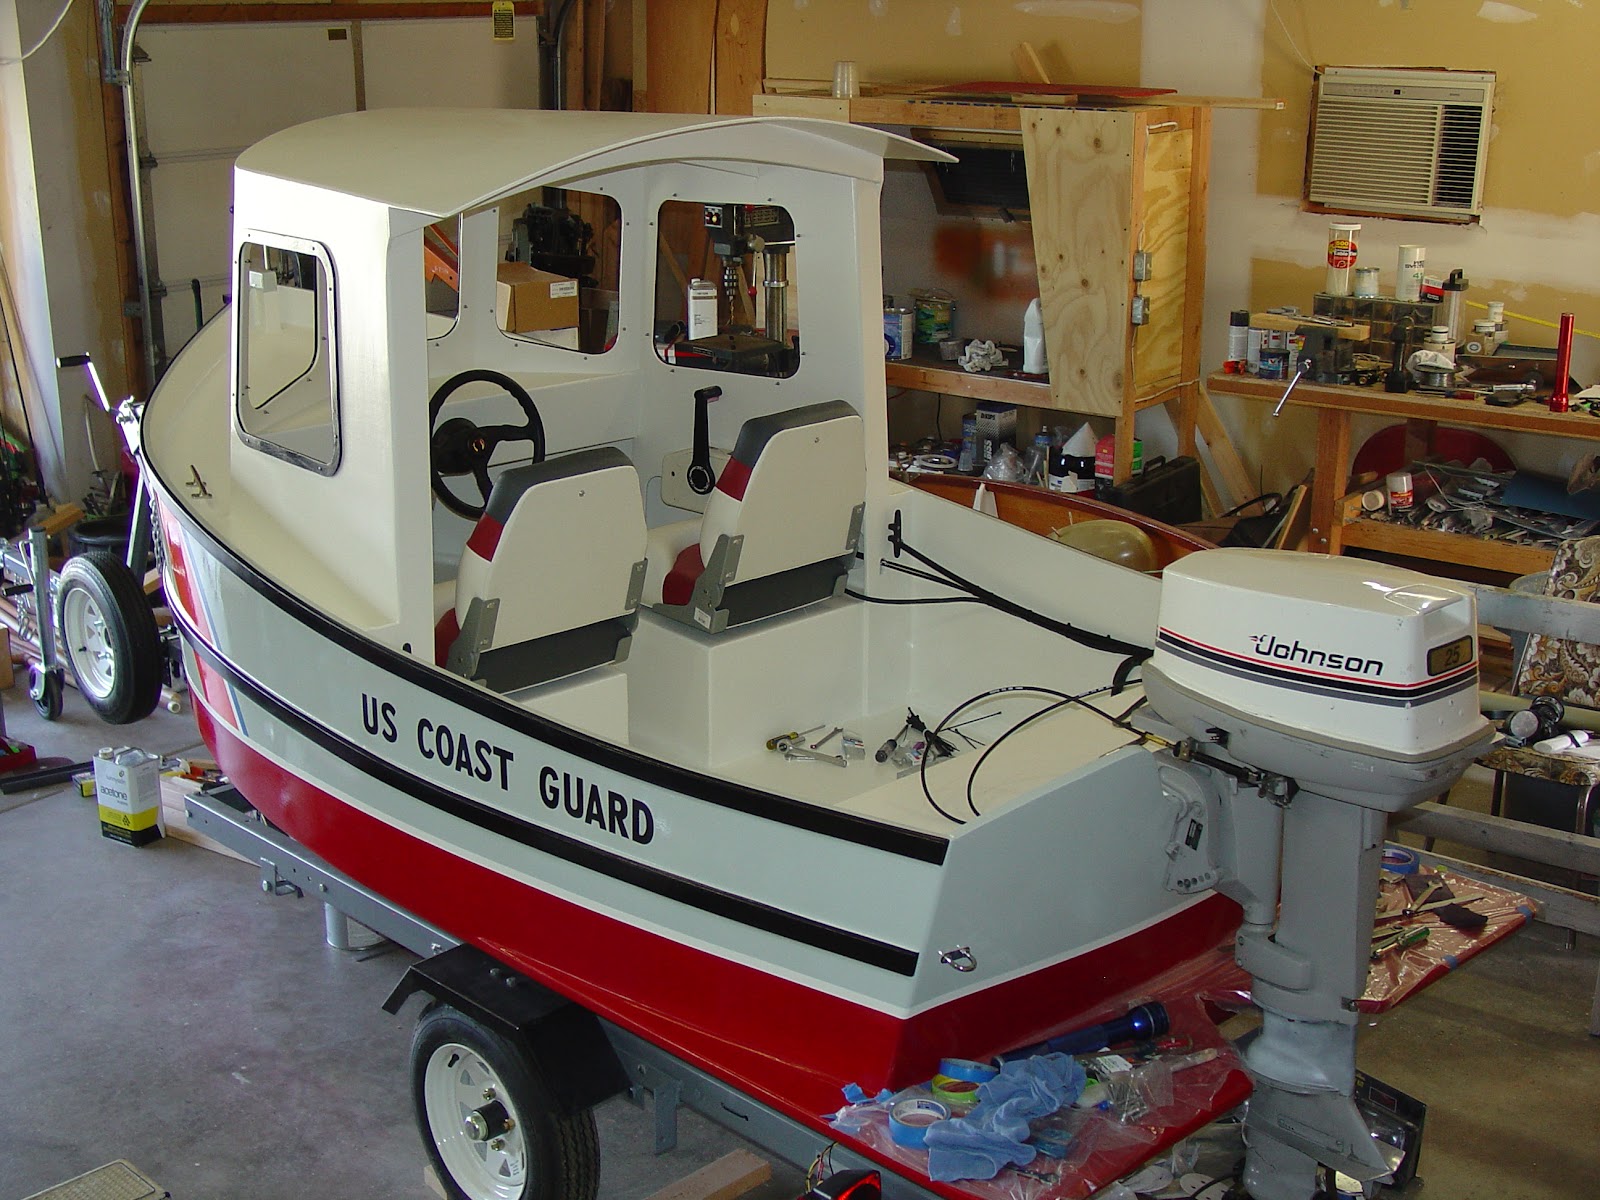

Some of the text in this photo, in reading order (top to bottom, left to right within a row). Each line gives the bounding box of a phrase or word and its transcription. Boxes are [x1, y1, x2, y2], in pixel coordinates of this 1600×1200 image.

[1254, 635, 1383, 676] Johnson
[1445, 645, 1461, 667] 25
[361, 692, 655, 845] US COAST GUARD
[100, 785, 128, 801] acetone
